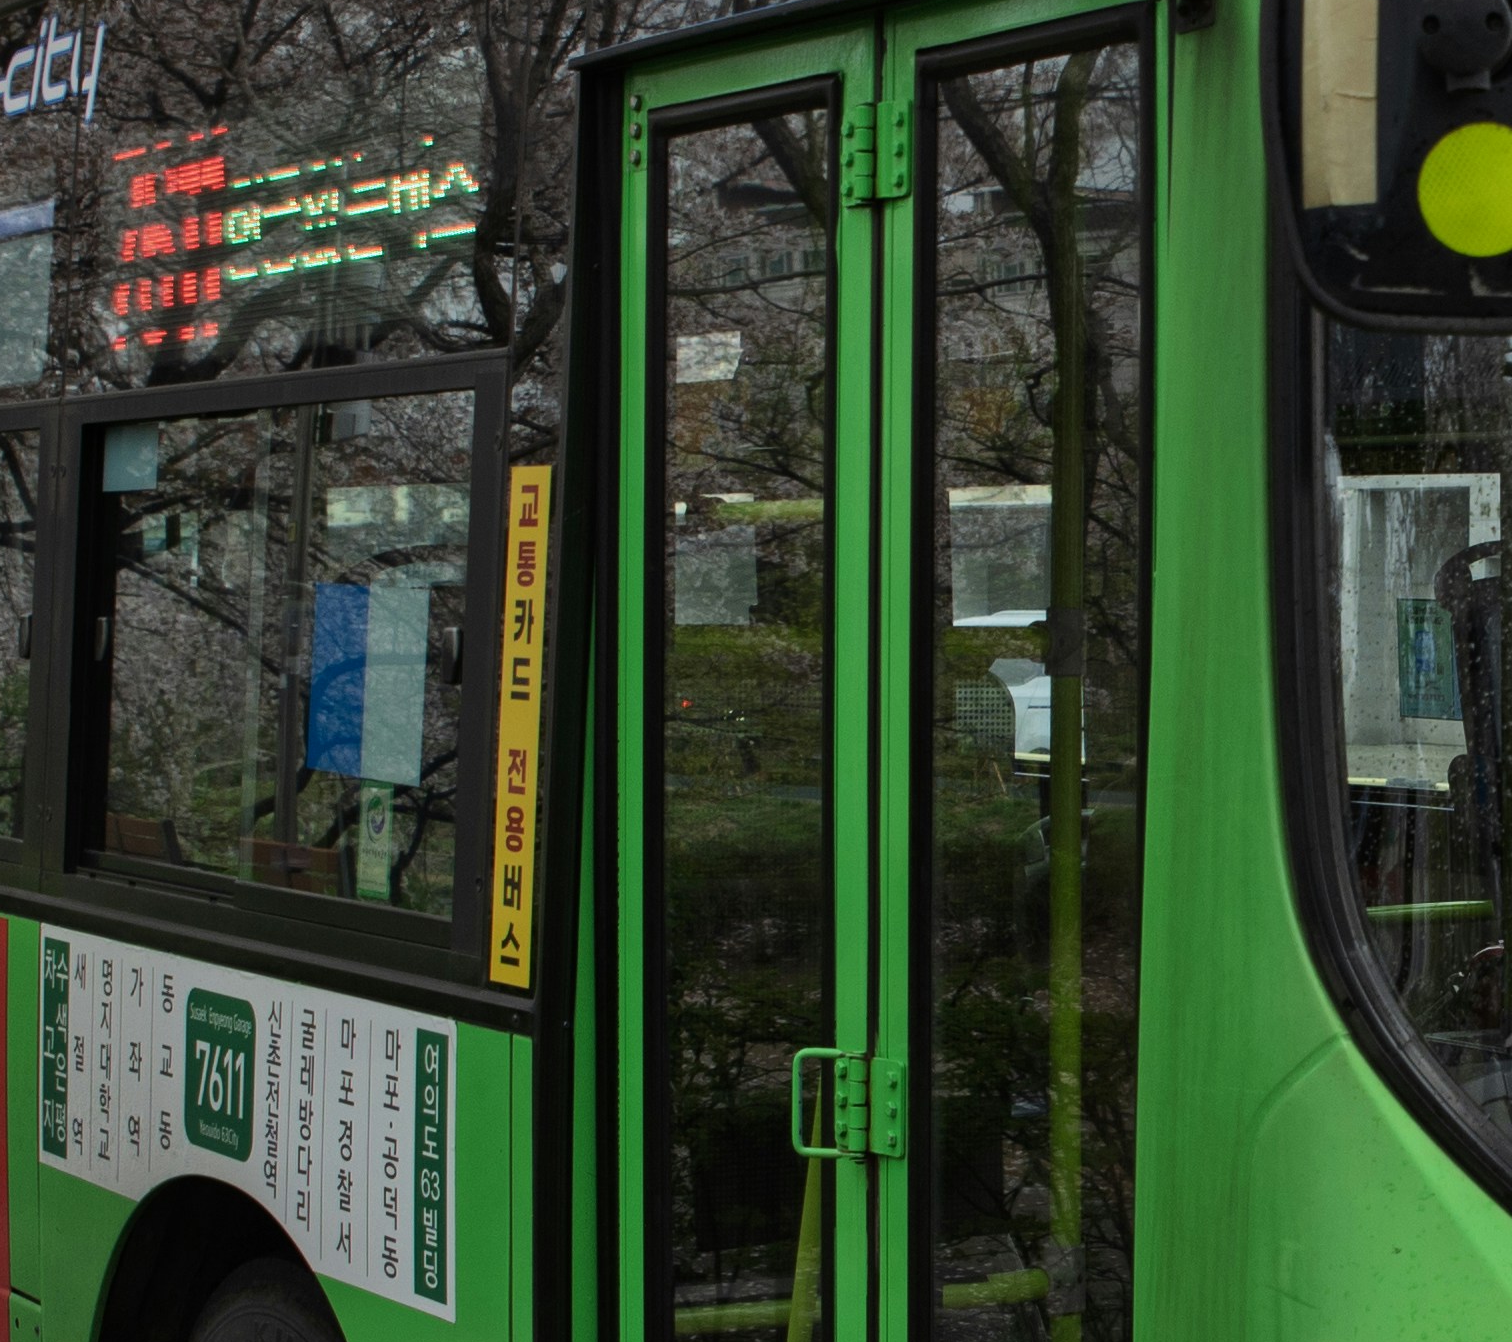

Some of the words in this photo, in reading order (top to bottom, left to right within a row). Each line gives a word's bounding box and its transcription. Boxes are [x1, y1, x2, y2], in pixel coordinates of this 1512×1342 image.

[509, 484, 541, 702] 교통카드
[499, 746, 527, 969] 전용버스
[70, 951, 88, 1157] 새절역
[97, 957, 115, 1162] 명지대학교
[126, 965, 144, 1160] 가좌역
[157, 972, 176, 1152] 동교동
[193, 1038, 248, 1122] 7611
[262, 998, 284, 1201] 신촌전철역
[295, 1007, 318, 1234] 굴레방다리
[335, 1016, 357, 1266] 마포경찰서
